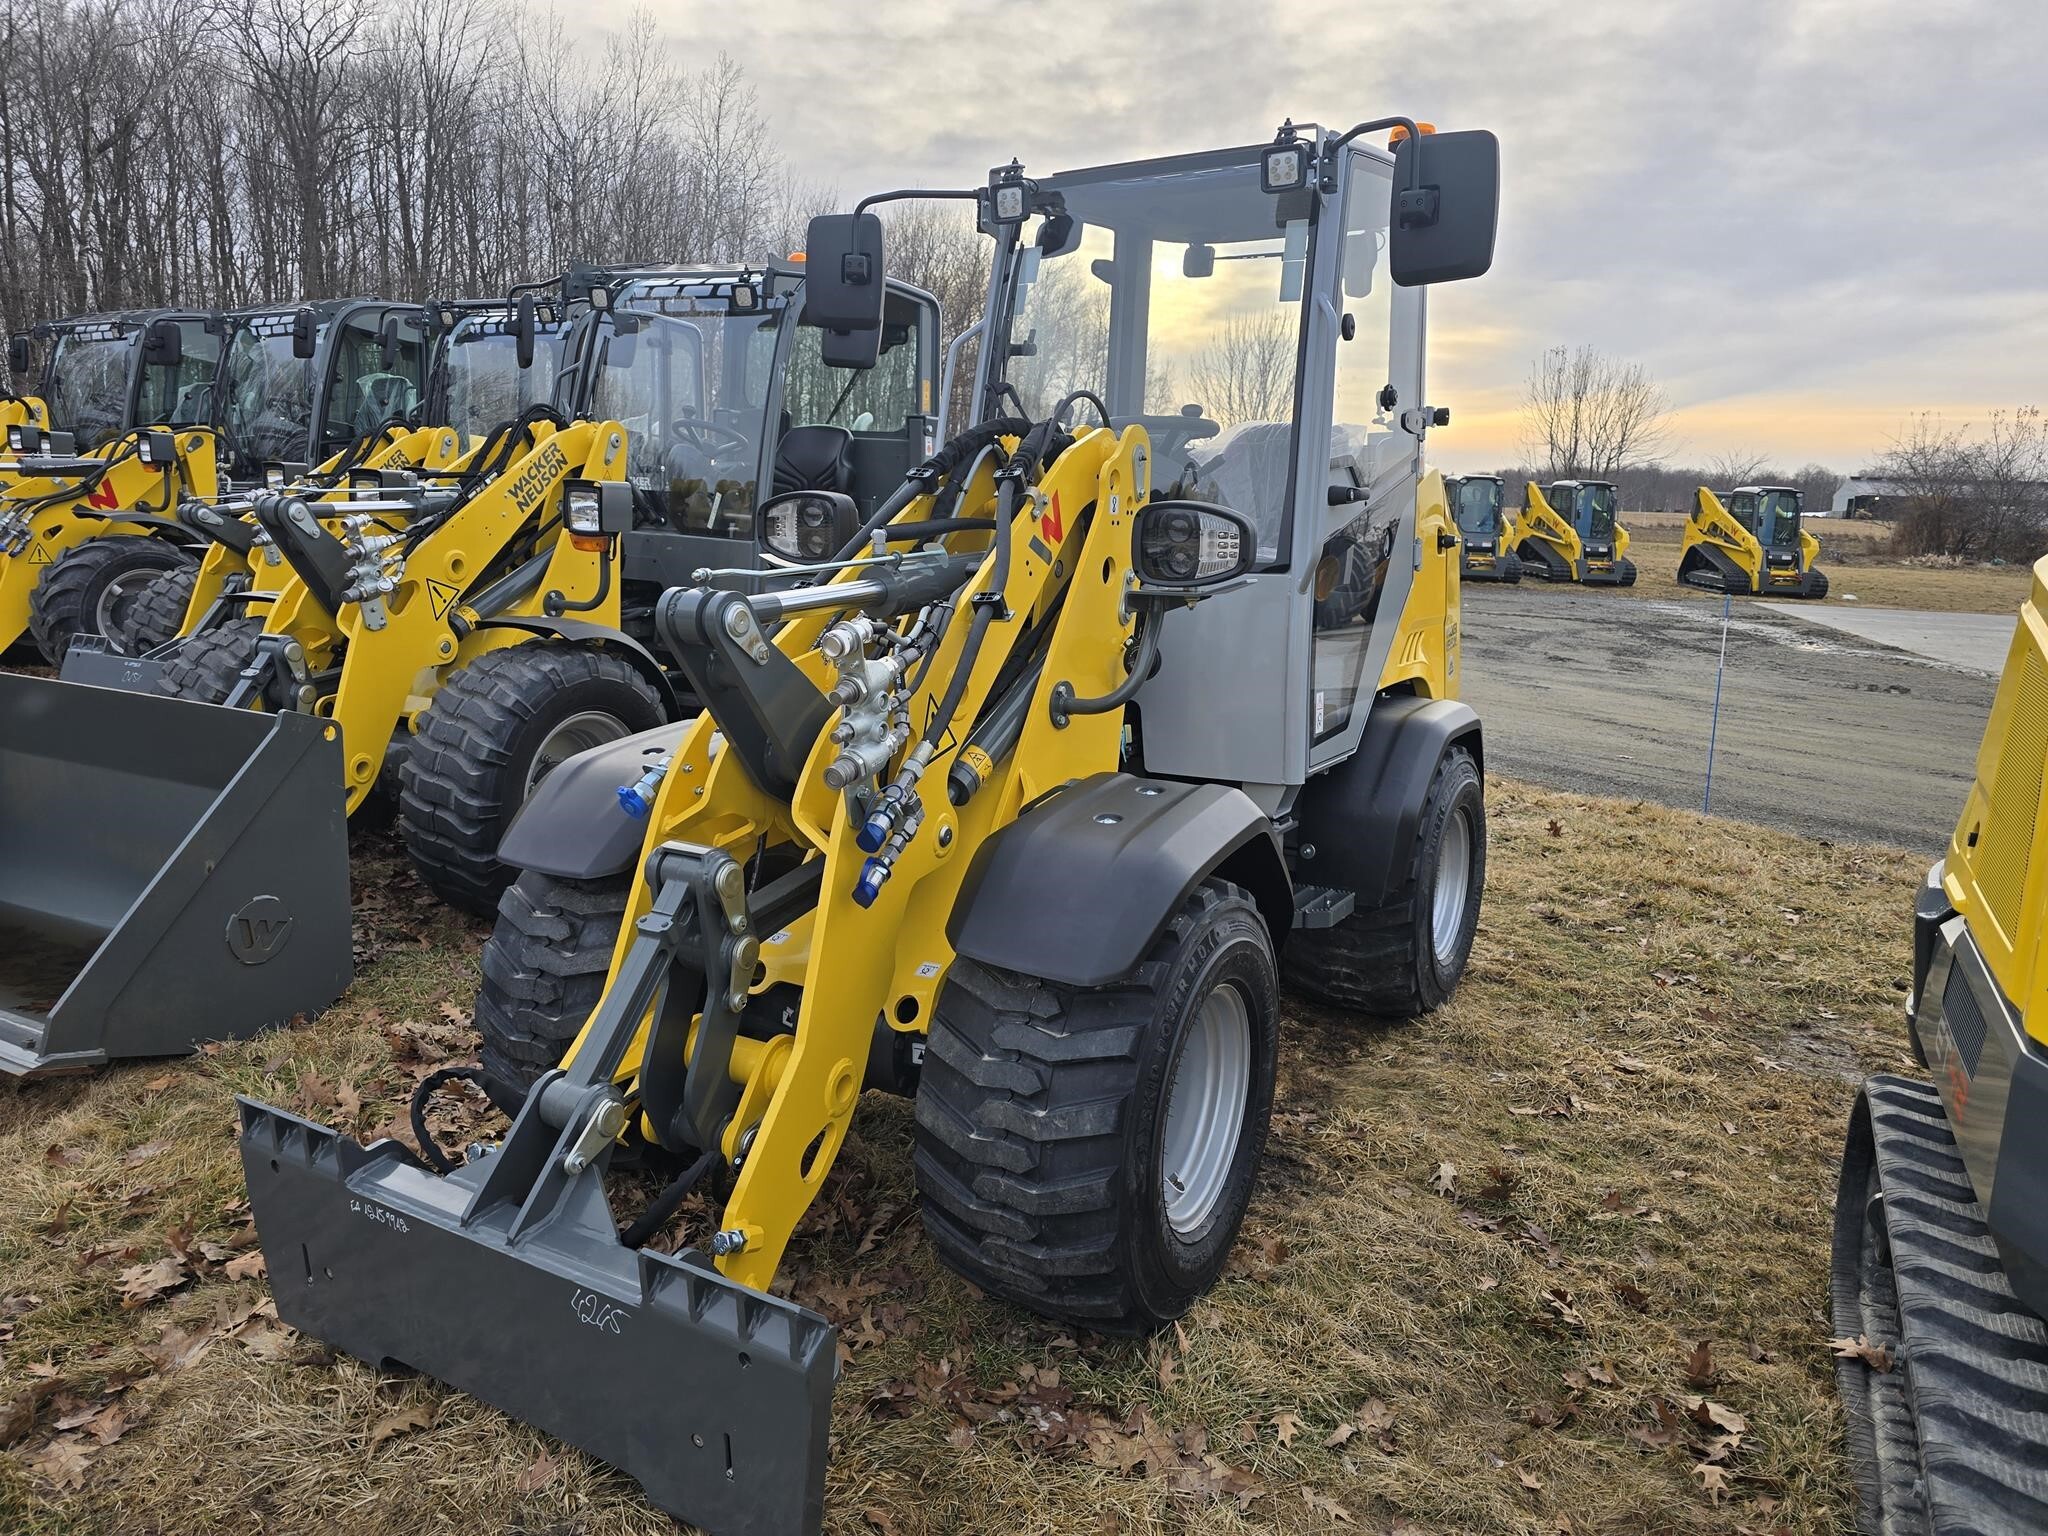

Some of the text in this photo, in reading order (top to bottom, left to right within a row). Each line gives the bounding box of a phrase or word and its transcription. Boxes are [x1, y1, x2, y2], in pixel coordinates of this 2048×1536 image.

[508, 441, 561, 499] WACKER
[516, 453, 569, 514] NEUSON
[1156, 978, 1191, 1056] POWER
